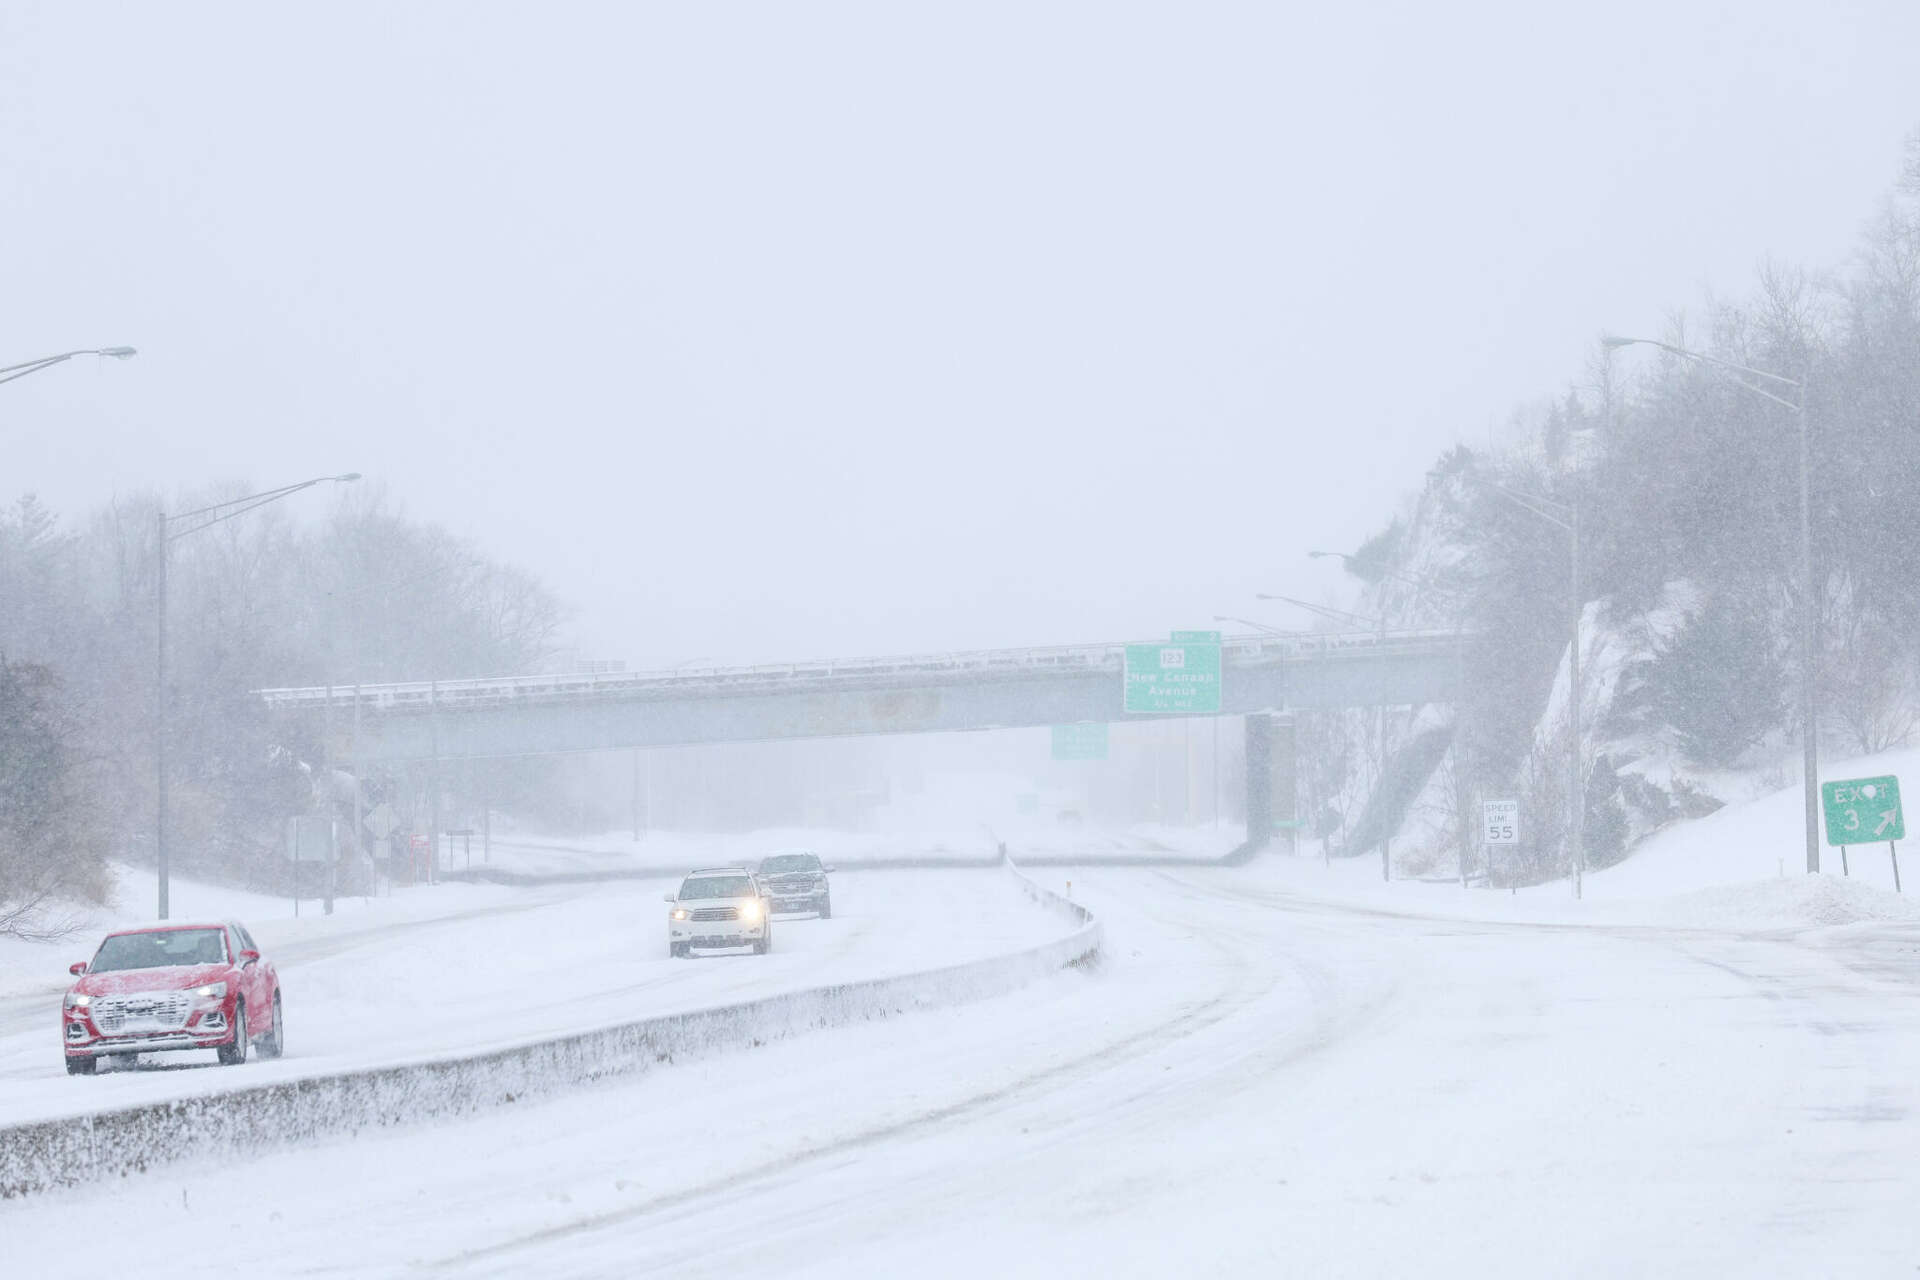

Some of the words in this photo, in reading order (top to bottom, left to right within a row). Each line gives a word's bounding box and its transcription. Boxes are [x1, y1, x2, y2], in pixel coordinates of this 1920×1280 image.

[1163, 653, 1182, 664] 123
[1132, 673, 1157, 682] New
[1164, 673, 1214, 682] Canaan
[1149, 686, 1197, 696] Avenue
[1835, 783, 1889, 803] EXT
[1485, 803, 1517, 812] SPEED
[1488, 815, 1511, 823] LIMI
[1844, 809, 1859, 830] 3
[1490, 826, 1513, 839] 55
